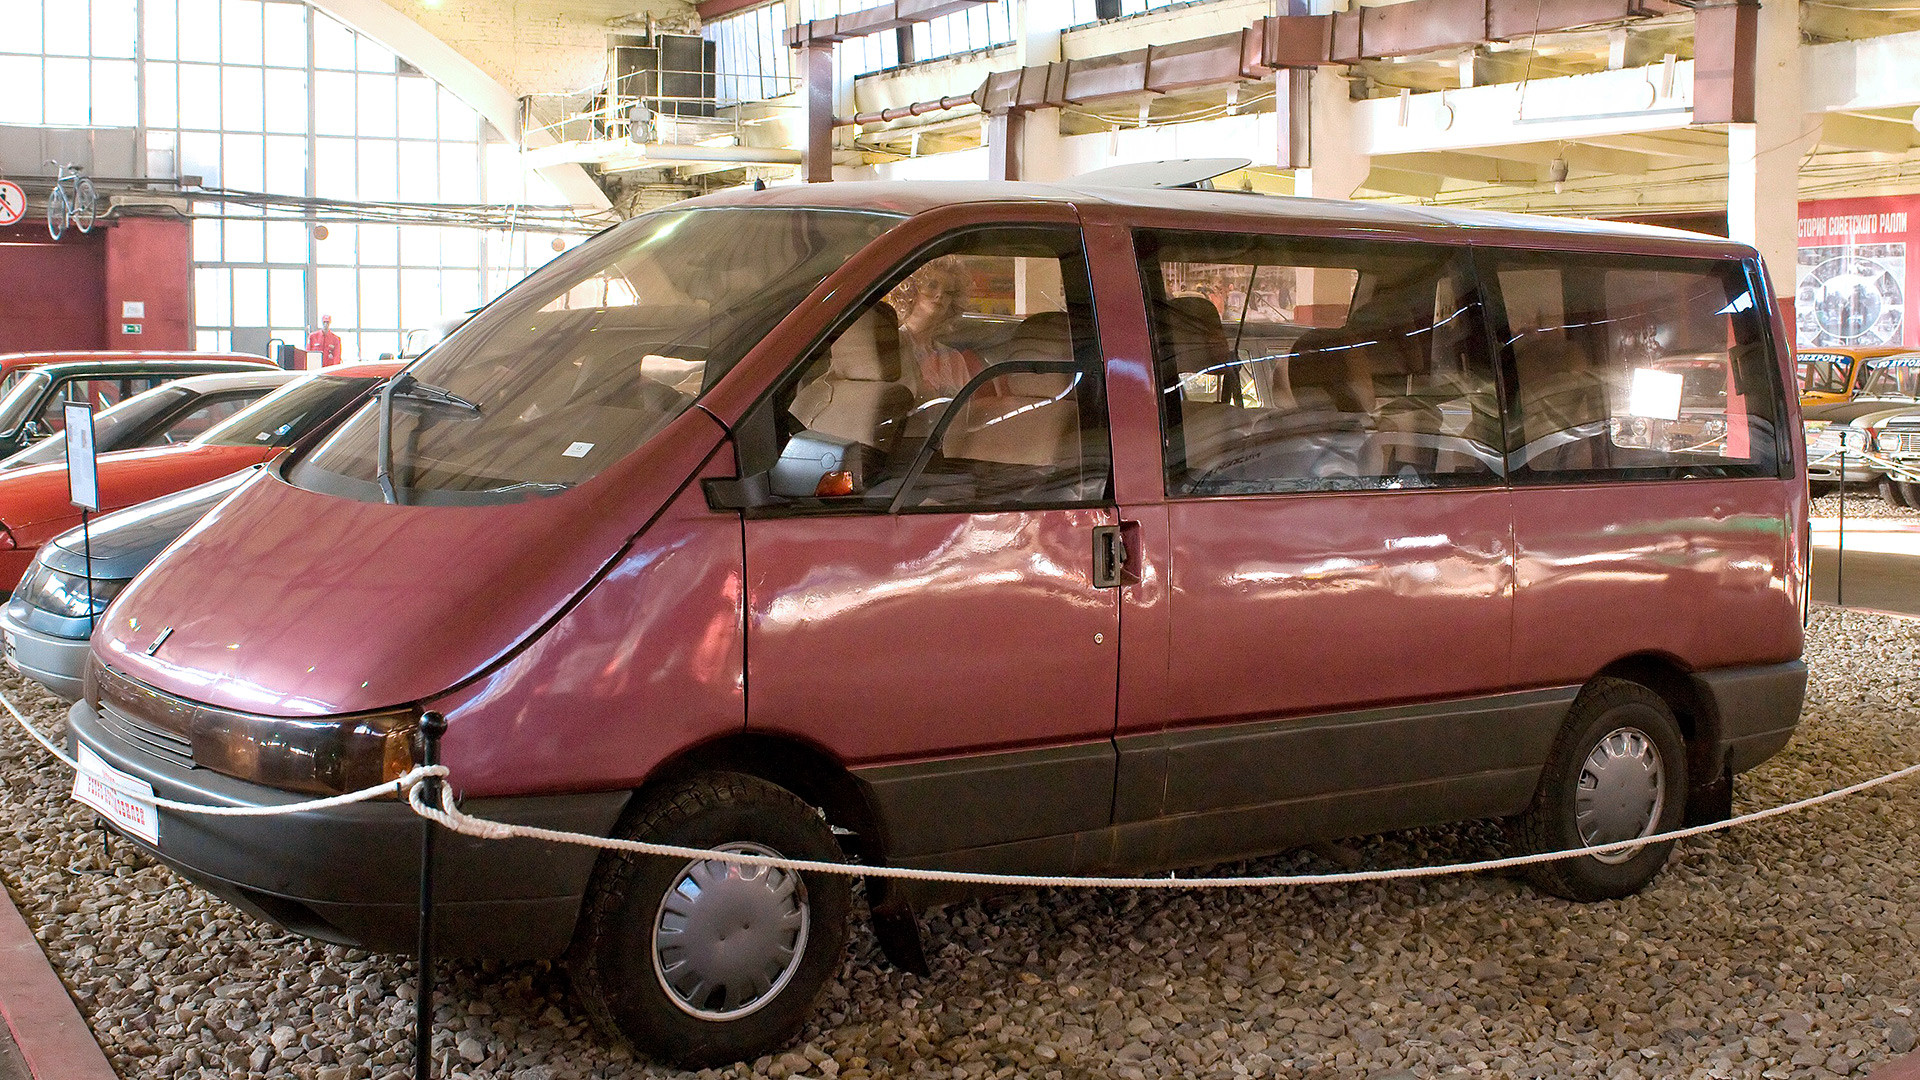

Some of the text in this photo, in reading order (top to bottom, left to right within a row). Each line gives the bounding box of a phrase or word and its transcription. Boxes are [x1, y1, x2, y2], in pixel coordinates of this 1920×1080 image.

[1798, 212, 1907, 237] СТОРИЯ СОВЕТСКОГО РАЛЛИ
[1797, 353, 1844, 364] OEXPORT
